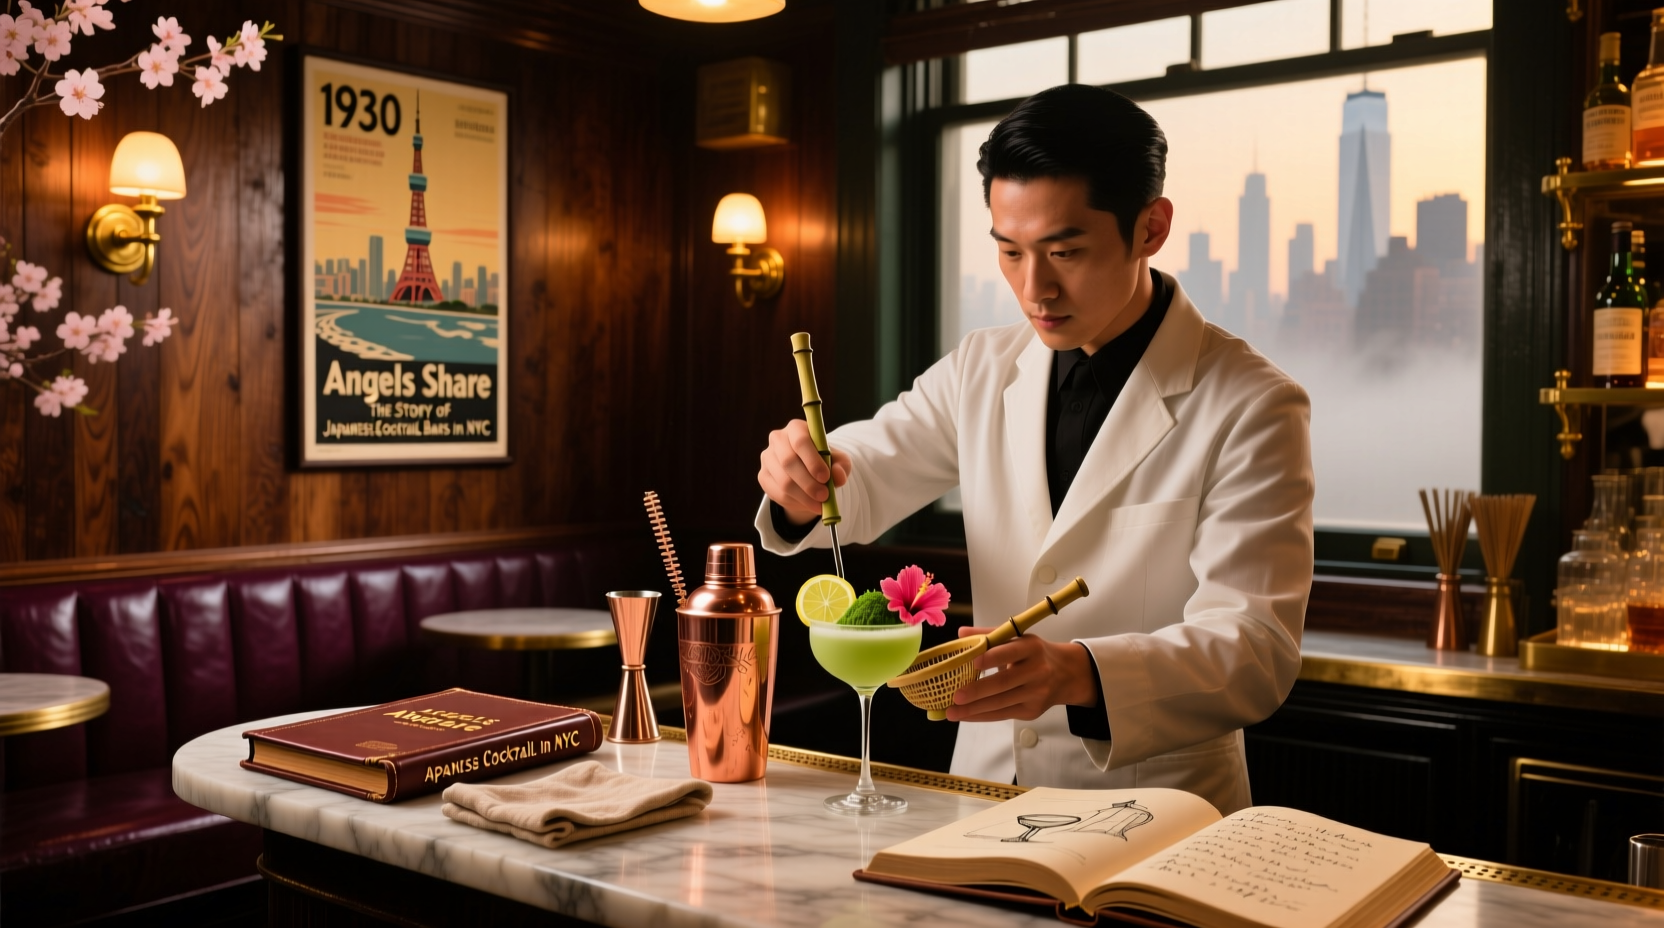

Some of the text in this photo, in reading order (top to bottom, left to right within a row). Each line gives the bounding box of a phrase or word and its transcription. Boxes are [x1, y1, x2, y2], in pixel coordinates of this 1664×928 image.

[320, 82, 402, 136] 1930
[322, 360, 492, 404] Angels Share
[466, 419, 492, 437] NYC
[554, 729, 581, 752] NYC
